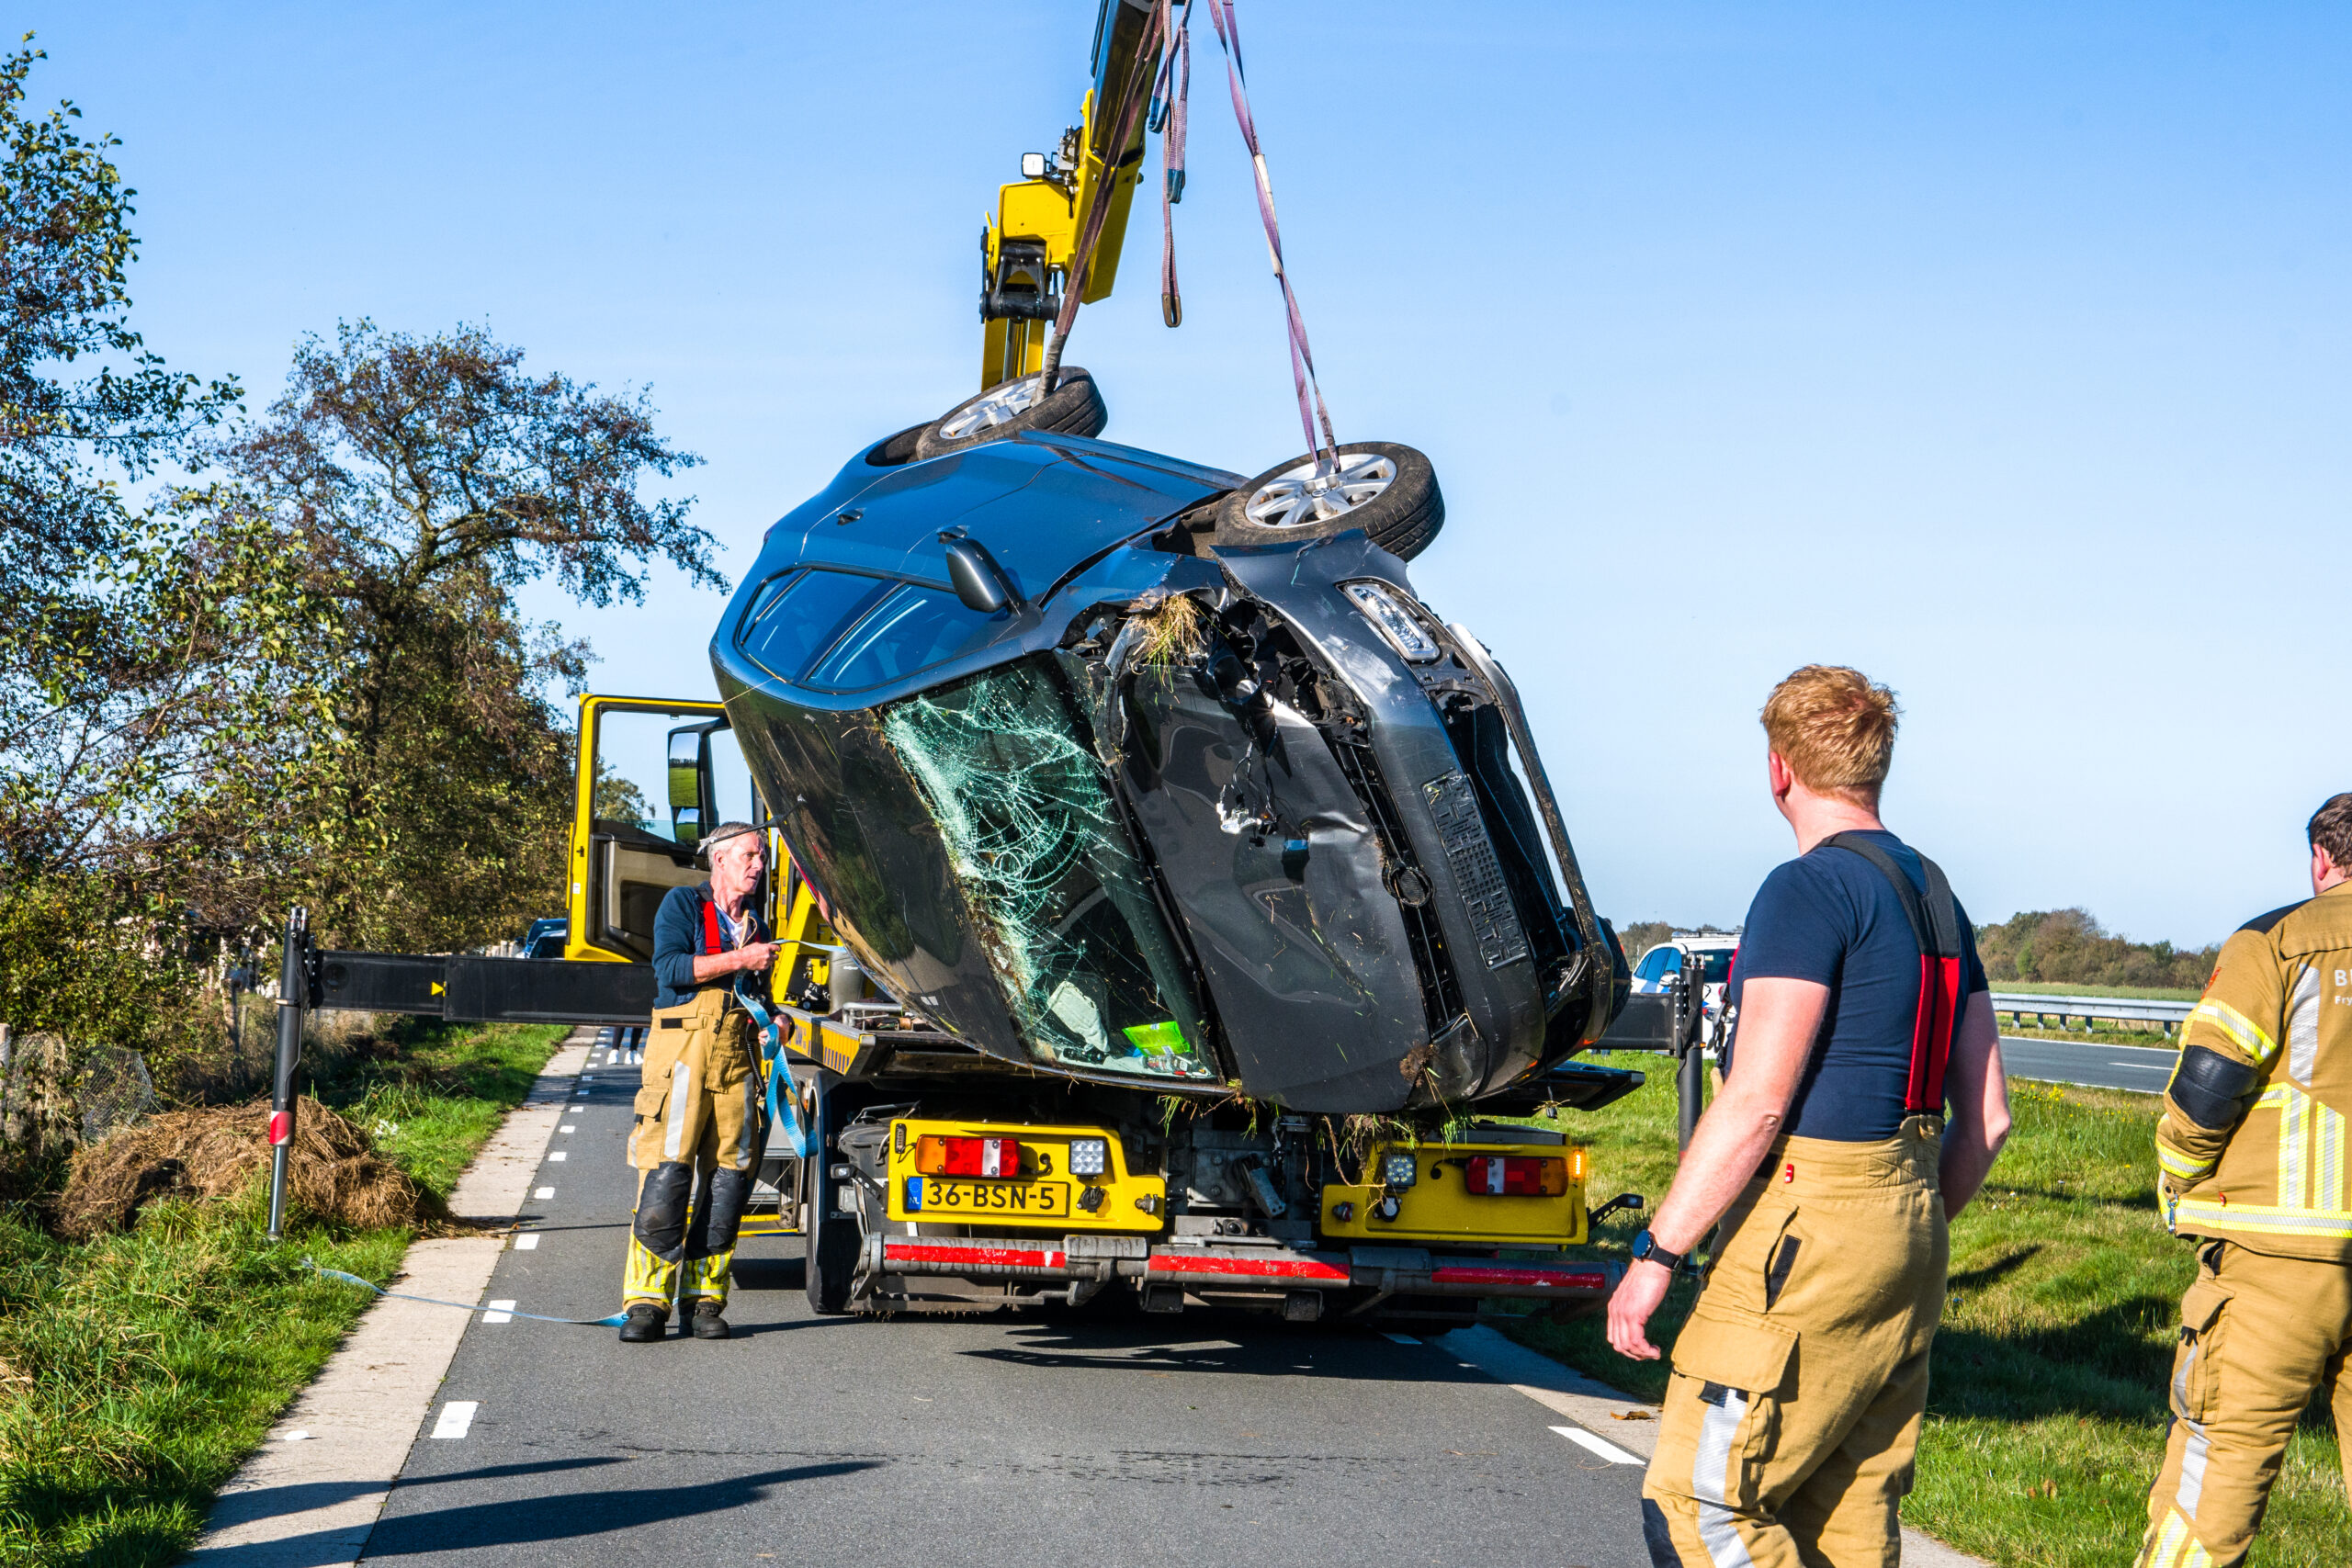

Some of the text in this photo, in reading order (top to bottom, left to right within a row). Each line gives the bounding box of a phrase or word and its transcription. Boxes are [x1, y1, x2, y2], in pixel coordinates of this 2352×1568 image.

[2335, 968, 2352, 987] B
[909, 1196, 920, 1205] NL
[927, 1182, 1055, 1210] 36-BSN-5
